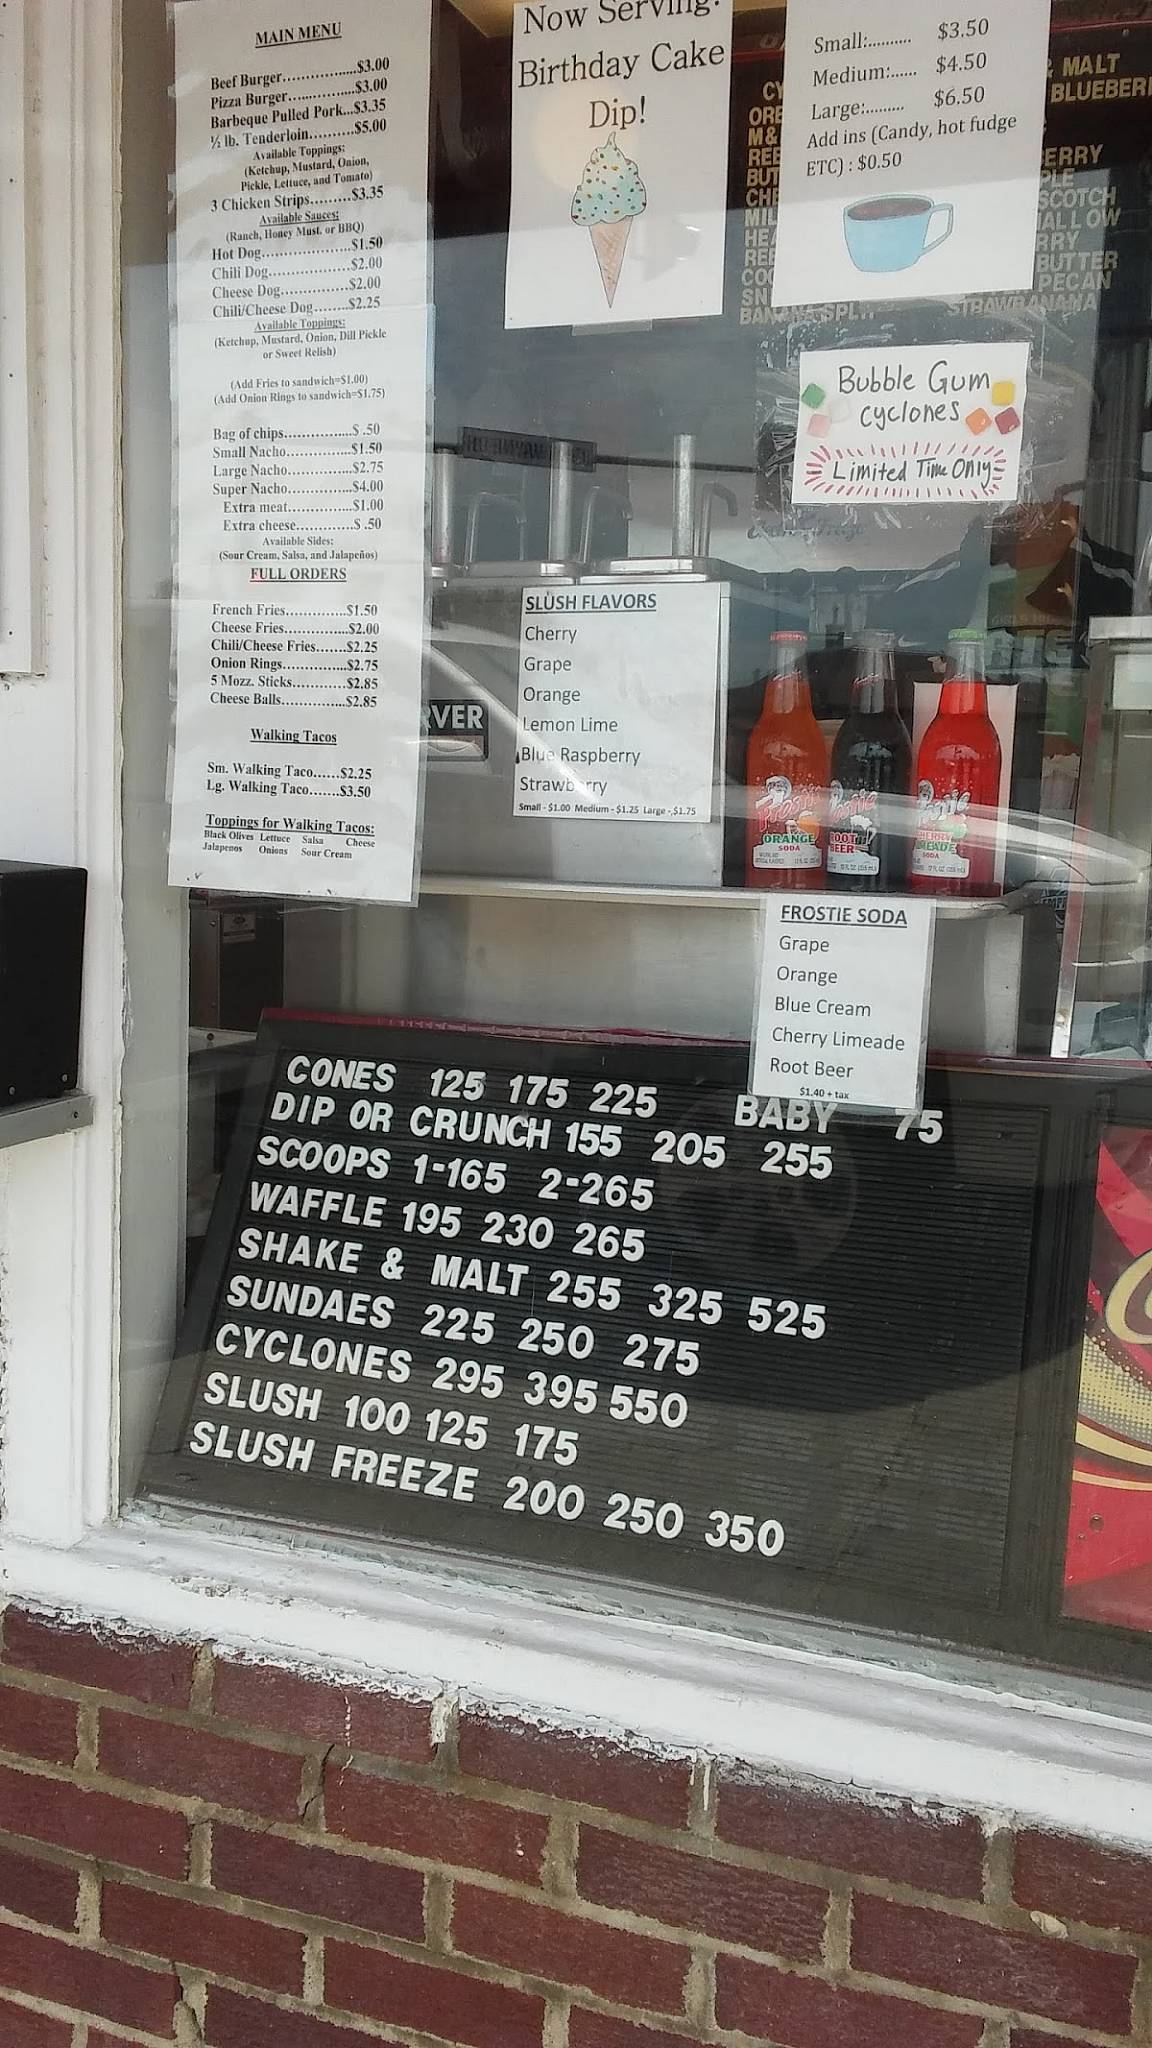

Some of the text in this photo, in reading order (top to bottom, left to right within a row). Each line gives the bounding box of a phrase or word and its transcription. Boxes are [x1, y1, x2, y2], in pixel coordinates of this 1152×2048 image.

[524, 6, 588, 34] Now
[937, 18, 990, 41] $3.50
[255, 22, 342, 46] MAIN MENU
[518, 40, 725, 88] Birthday Cake
[935, 52, 988, 75] $4.50
[1062, 53, 1121, 77] MALT
[210, 76, 238, 90] Beef
[934, 86, 986, 109] $6.50
[210, 114, 268, 130] Barbeque
[272, 107, 310, 123] Pulled
[589, 95, 646, 130] Dip!
[806, 113, 1018, 149] Add ins (Candy, hot fudge
[806, 155, 844, 179] ETC)
[857, 151, 903, 172] $0.50
[1038, 270, 1112, 292] PECAN
[838, 360, 990, 394] Bubble Gum
[833, 459, 907, 482] Limited
[250, 567, 347, 581] FULL ORDERS
[526, 593, 657, 611] SLUSH FLAVORS
[525, 626, 578, 644] Cherry
[210, 657, 246, 669] Onion
[524, 657, 572, 675] Grape
[523, 687, 581, 706] Orange
[250, 728, 337, 743] Walking Tacos
[523, 716, 618, 733] Lemon Lime
[521, 747, 641, 767] Blue Raspberry
[207, 761, 229, 775] Sm.
[232, 762, 281, 779] Walking
[520, 776, 608, 796] Strawbrry
[518, 803, 542, 812] Small
[548, 803, 571, 813] $1.00
[574, 804, 610, 814] Medium
[616, 805, 640, 815] $1.25
[643, 806, 666, 817] Large
[205, 813, 375, 834] Toppings for Walking Tacos:
[204, 830, 376, 849] Black Olives Lettuce Salsa Cheese
[764, 834, 816, 844] ORANGE
[781, 904, 908, 925] FROSTIE SODA
[779, 935, 830, 955] Grape
[776, 966, 839, 986] Orange
[775, 996, 872, 1017] Blue Cream
[772, 1027, 905, 1051] Cherry Limeade
[770, 1057, 854, 1078] Root Beer
[286, 1055, 944, 1144] CONES 125 175 225 BABY 75
[799, 1087, 825, 1098] $1.40
[834, 1089, 849, 1100] tax
[270, 1091, 833, 1180] DIP OR CRUNCH 155 205 255
[256, 1135, 655, 1212] SCOOPS 1-165 2-265
[250, 1181, 646, 1262] WAFFLE 195 230 265
[238, 1227, 828, 1340] SHAKE & MALT 255 325 525
[226, 1274, 701, 1376] SUNDAES 225 250 275
[215, 1323, 688, 1430] CYCLONES 295 395 550
[203, 1371, 580, 1467] SLUSH 100 125 175
[189, 1421, 786, 1558] SLUSH FREEZE 200 250 350
